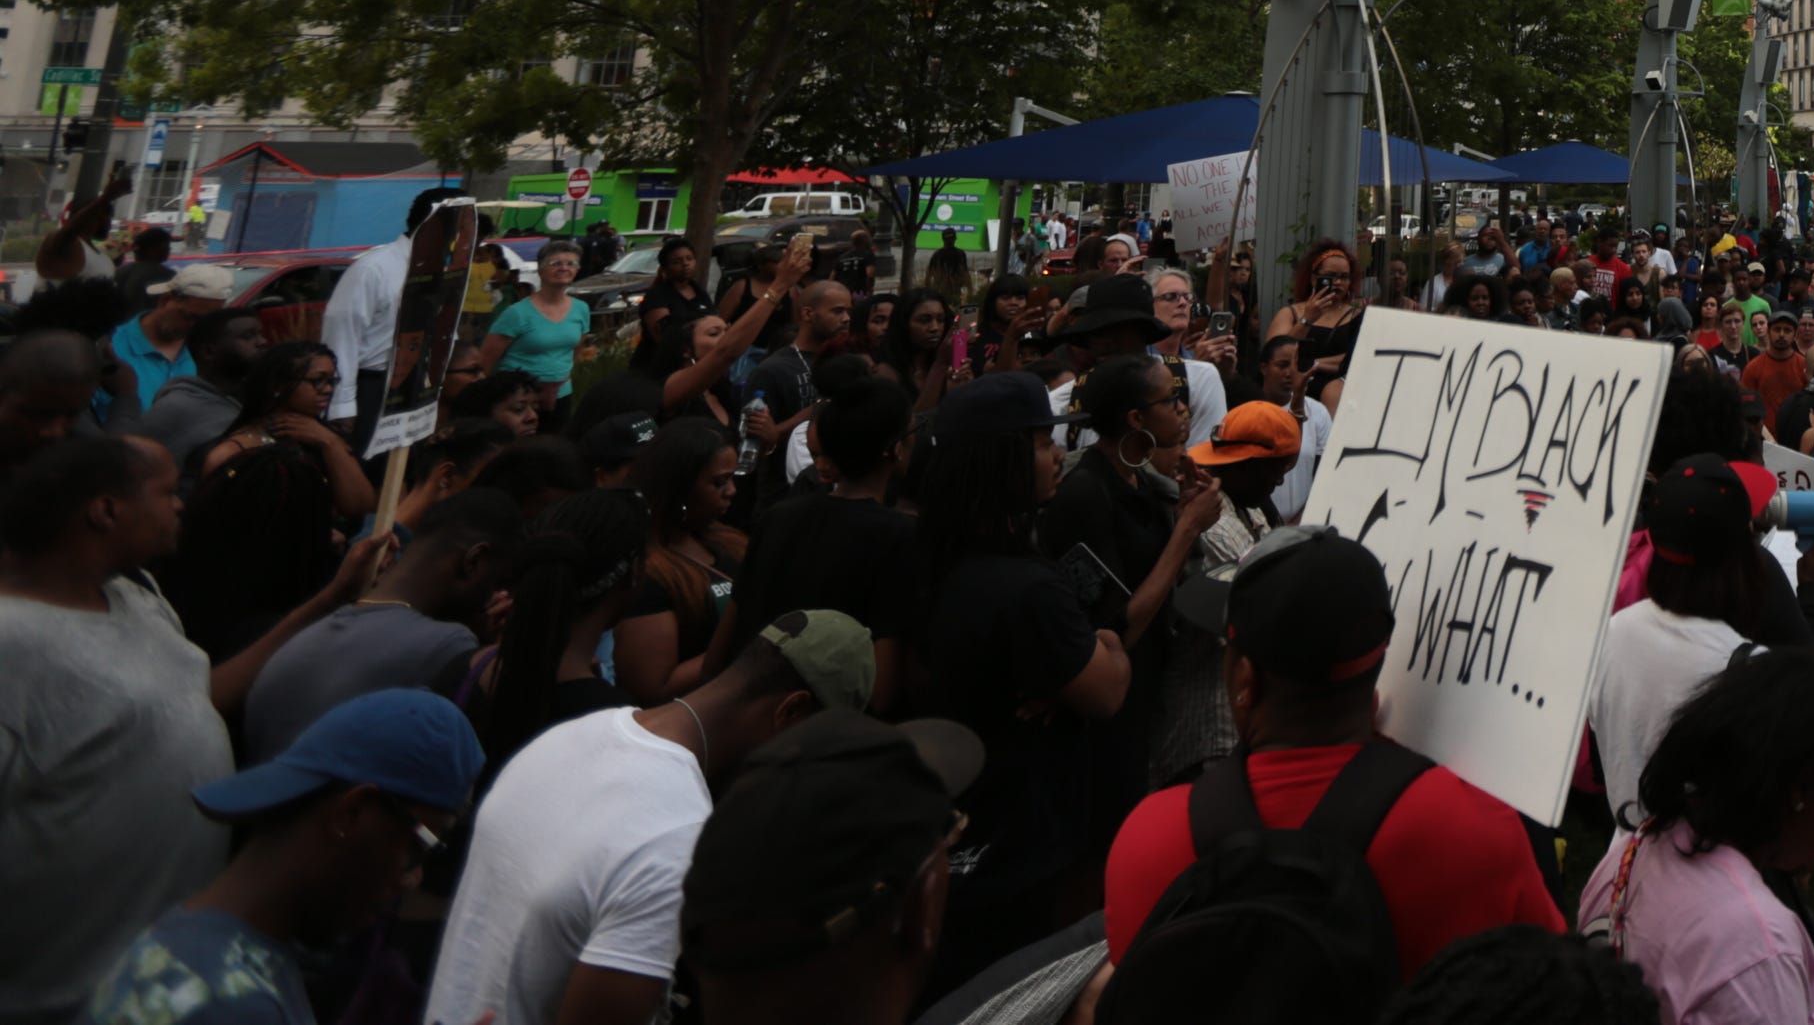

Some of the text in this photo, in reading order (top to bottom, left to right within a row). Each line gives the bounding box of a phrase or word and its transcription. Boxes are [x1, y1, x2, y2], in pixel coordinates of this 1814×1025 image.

[1172, 164, 1199, 187] NO
[1202, 158, 1232, 177] ONE
[1200, 180, 1232, 200] THE
[1466, 349, 1640, 527] BLACK
